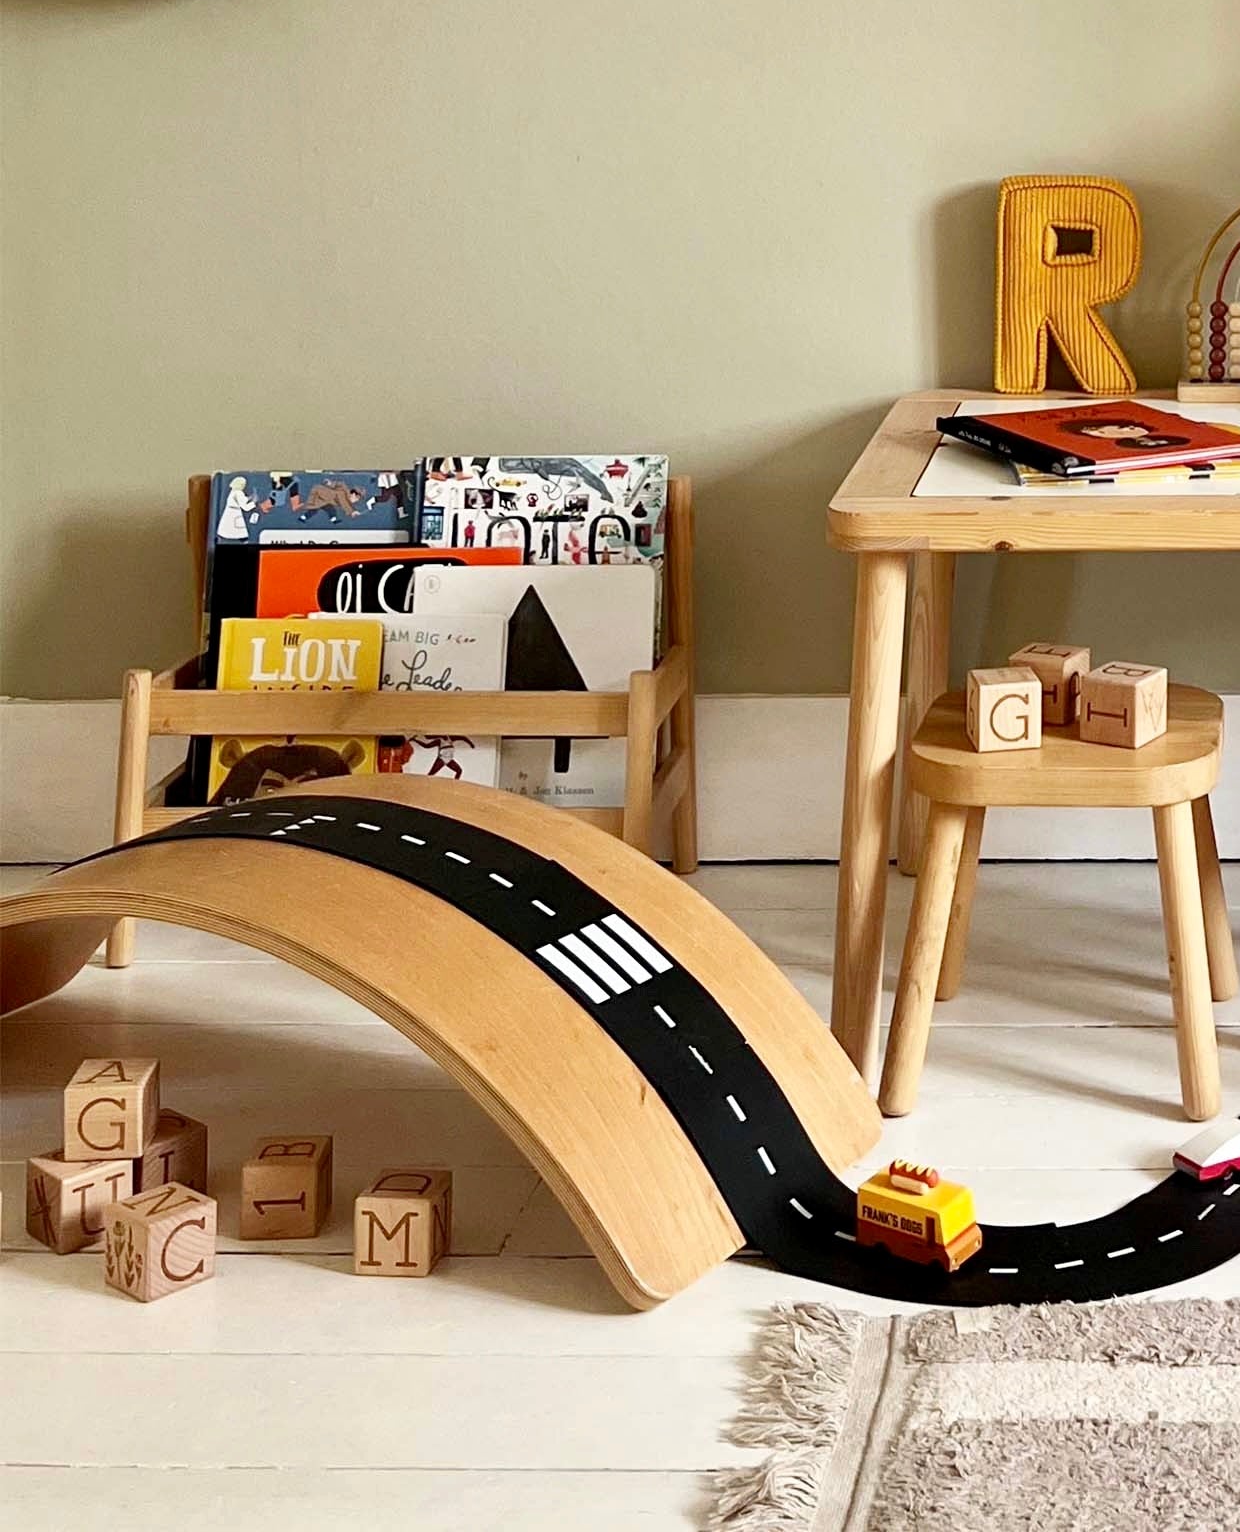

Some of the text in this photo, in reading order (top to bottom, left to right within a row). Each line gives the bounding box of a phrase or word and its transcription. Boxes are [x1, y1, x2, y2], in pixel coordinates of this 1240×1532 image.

[993, 174, 1142, 394] R
[415, 631, 440, 646] BIG
[990, 693, 1029, 742] G
[77, 1061, 133, 1084] A
[78, 1097, 127, 1152] G
[161, 1216, 206, 1282] C
[360, 1210, 420, 1268] M
